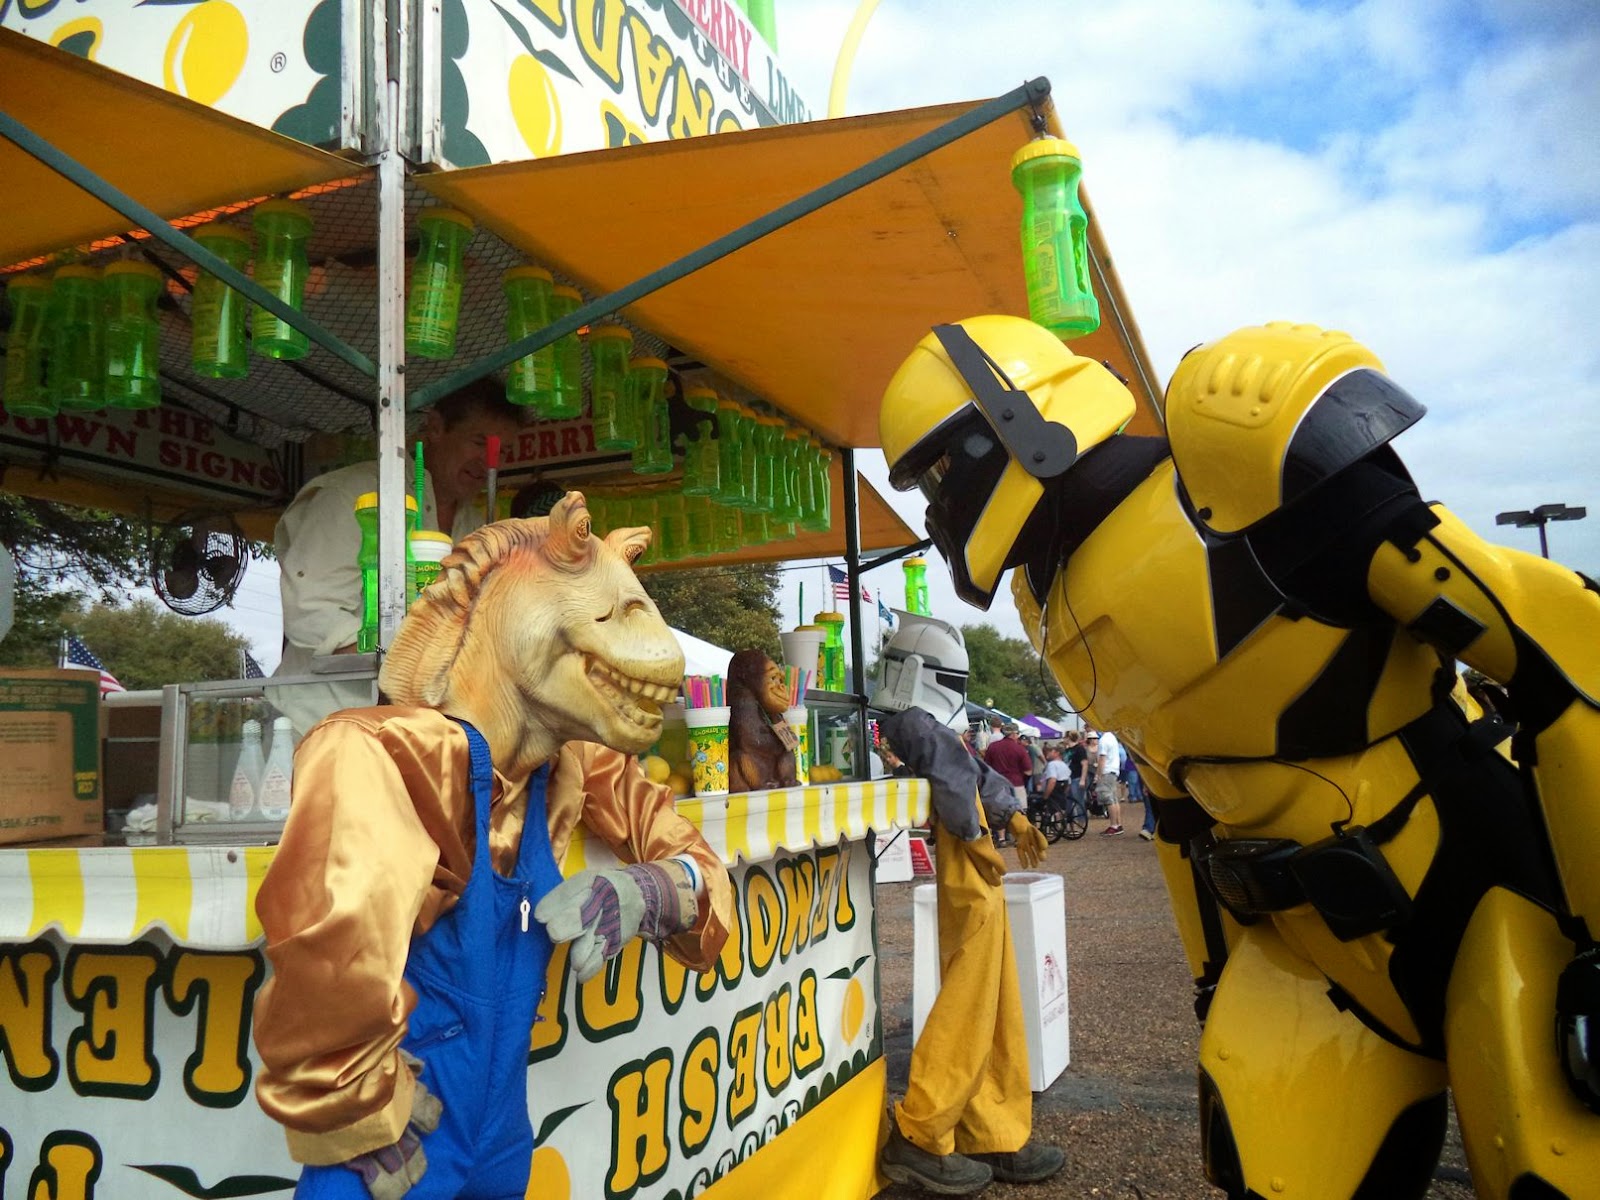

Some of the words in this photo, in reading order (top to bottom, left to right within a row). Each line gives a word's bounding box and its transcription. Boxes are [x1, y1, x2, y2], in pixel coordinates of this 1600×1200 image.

[678, 0, 752, 81] ERRY
[766, 55, 813, 124] LIME
[0, 402, 137, 458] OWN
[159, 439, 281, 490] SIGNS
[134, 408, 215, 446] THE
[604, 968, 824, 1200] FRESH
